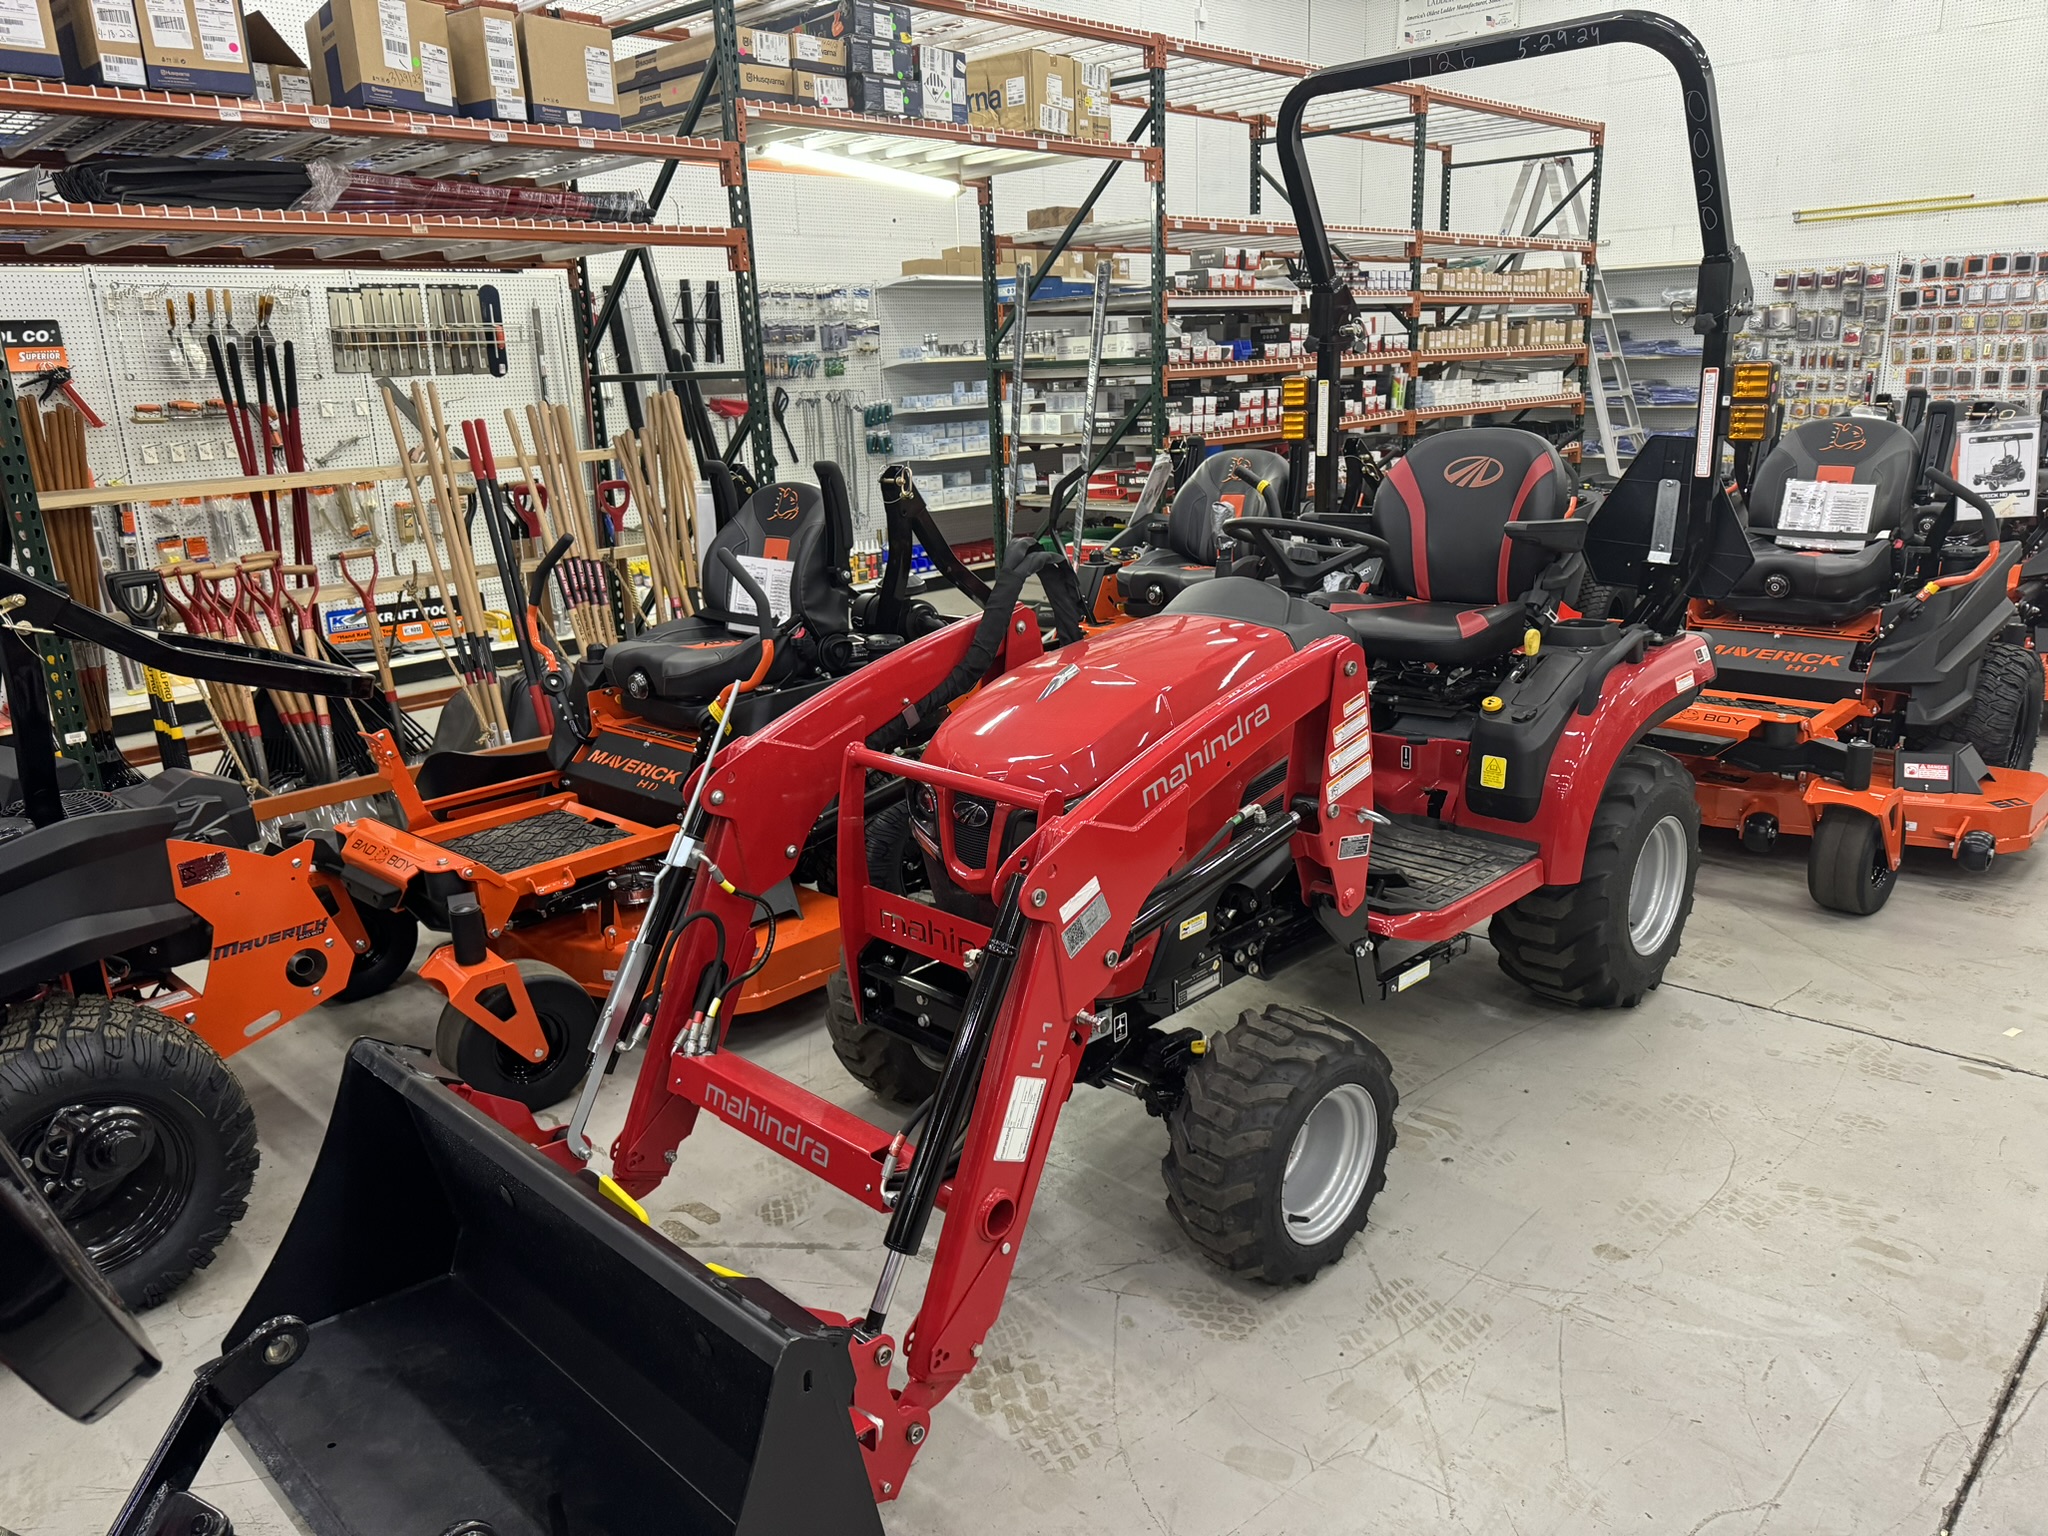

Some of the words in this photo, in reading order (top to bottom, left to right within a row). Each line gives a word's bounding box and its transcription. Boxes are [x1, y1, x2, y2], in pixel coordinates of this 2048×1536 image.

[1406, 12, 1426, 21] America's
[1426, 8, 1440, 17] Oldest
[1440, 5, 1456, 15] Ladder
[752, 74, 785, 86] Husqvarna
[22, 329, 54, 343] CO.
[18, 351, 61, 363] SUPERIOR
[423, 605, 457, 617] TOO
[1784, 663, 1818, 673] HD
[1703, 712, 1746, 726] BOY
[1142, 703, 1271, 809] mahindra
[587, 749, 683, 785] MAVERICK
[636, 779, 659, 791] HD
[351, 838, 378, 856] BAD
[387, 854, 414, 872] BOY
[213, 917, 329, 961] MAVERICK
[880, 908, 976, 957] mahin
[704, 1082, 829, 1168] mahindra
